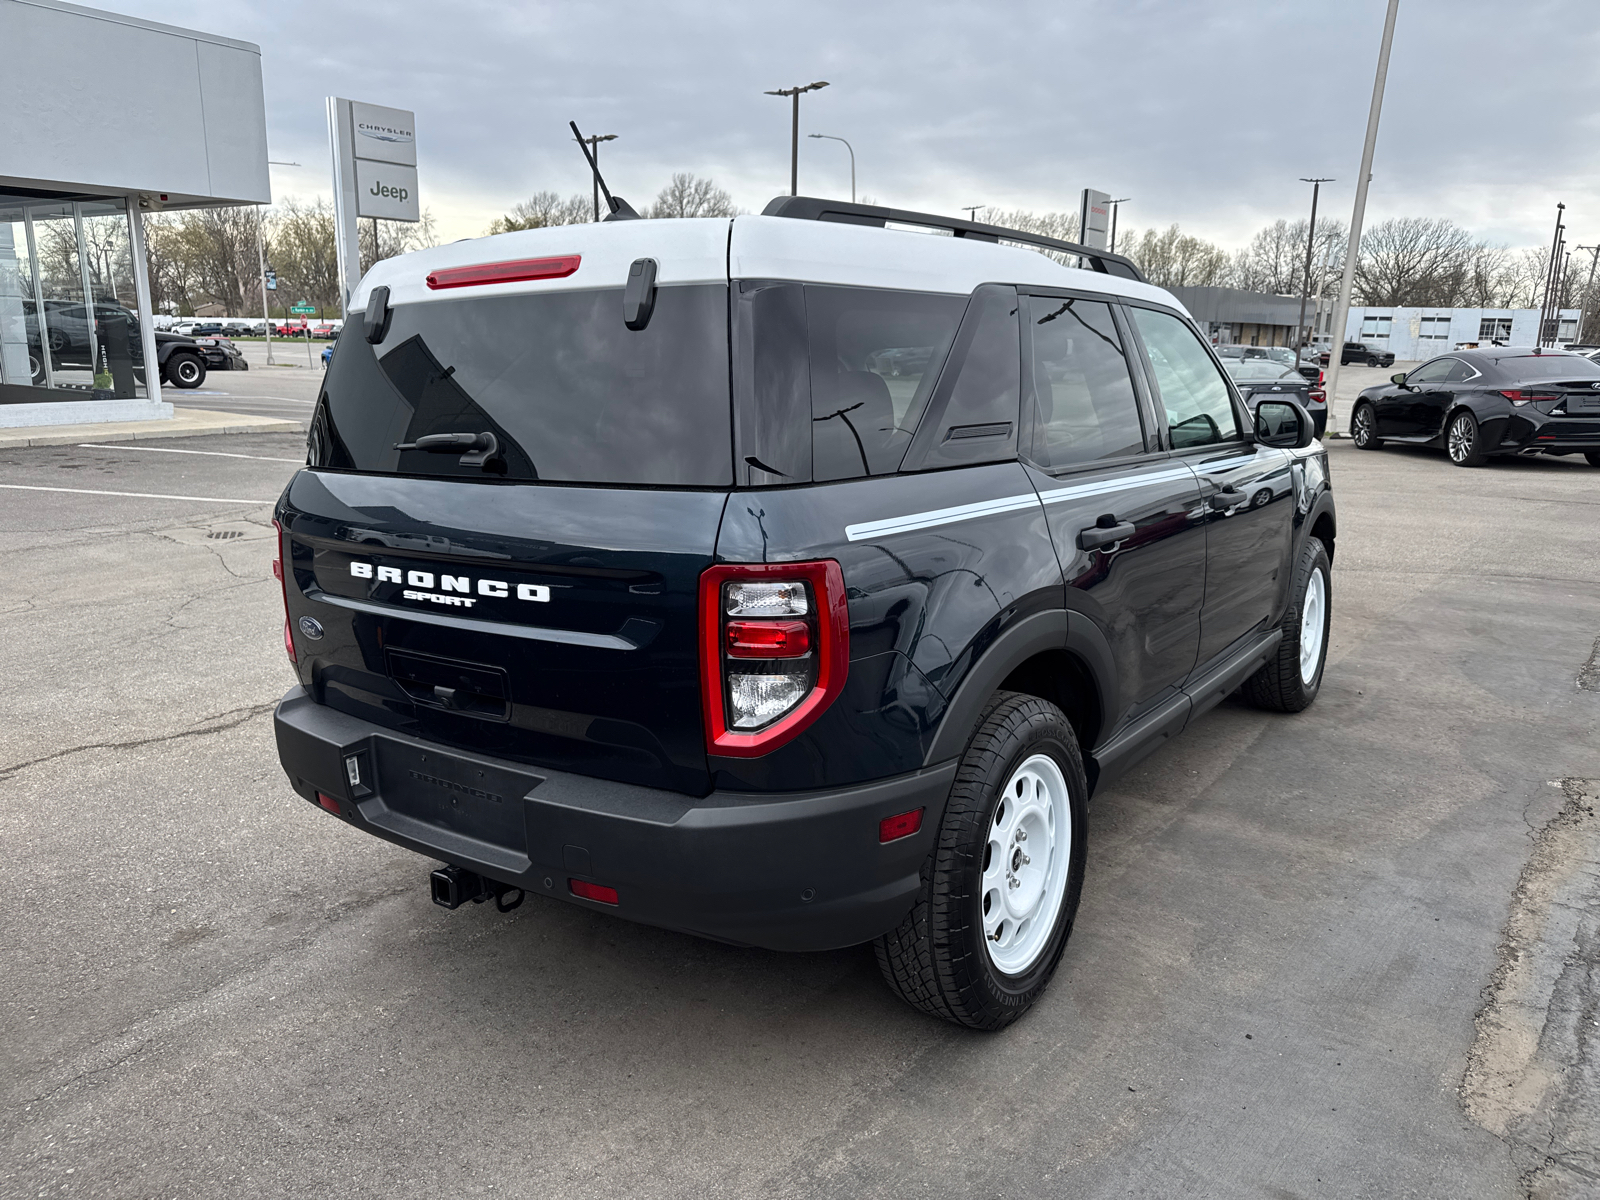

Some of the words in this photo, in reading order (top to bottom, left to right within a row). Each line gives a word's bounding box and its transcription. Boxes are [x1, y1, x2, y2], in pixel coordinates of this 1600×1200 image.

[359, 123, 412, 137] CHRYSLER
[370, 181, 408, 202] Jeep
[350, 561, 551, 602] BRONCO
[402, 590, 477, 608] SPORT
[409, 769, 503, 803] BRONCO
